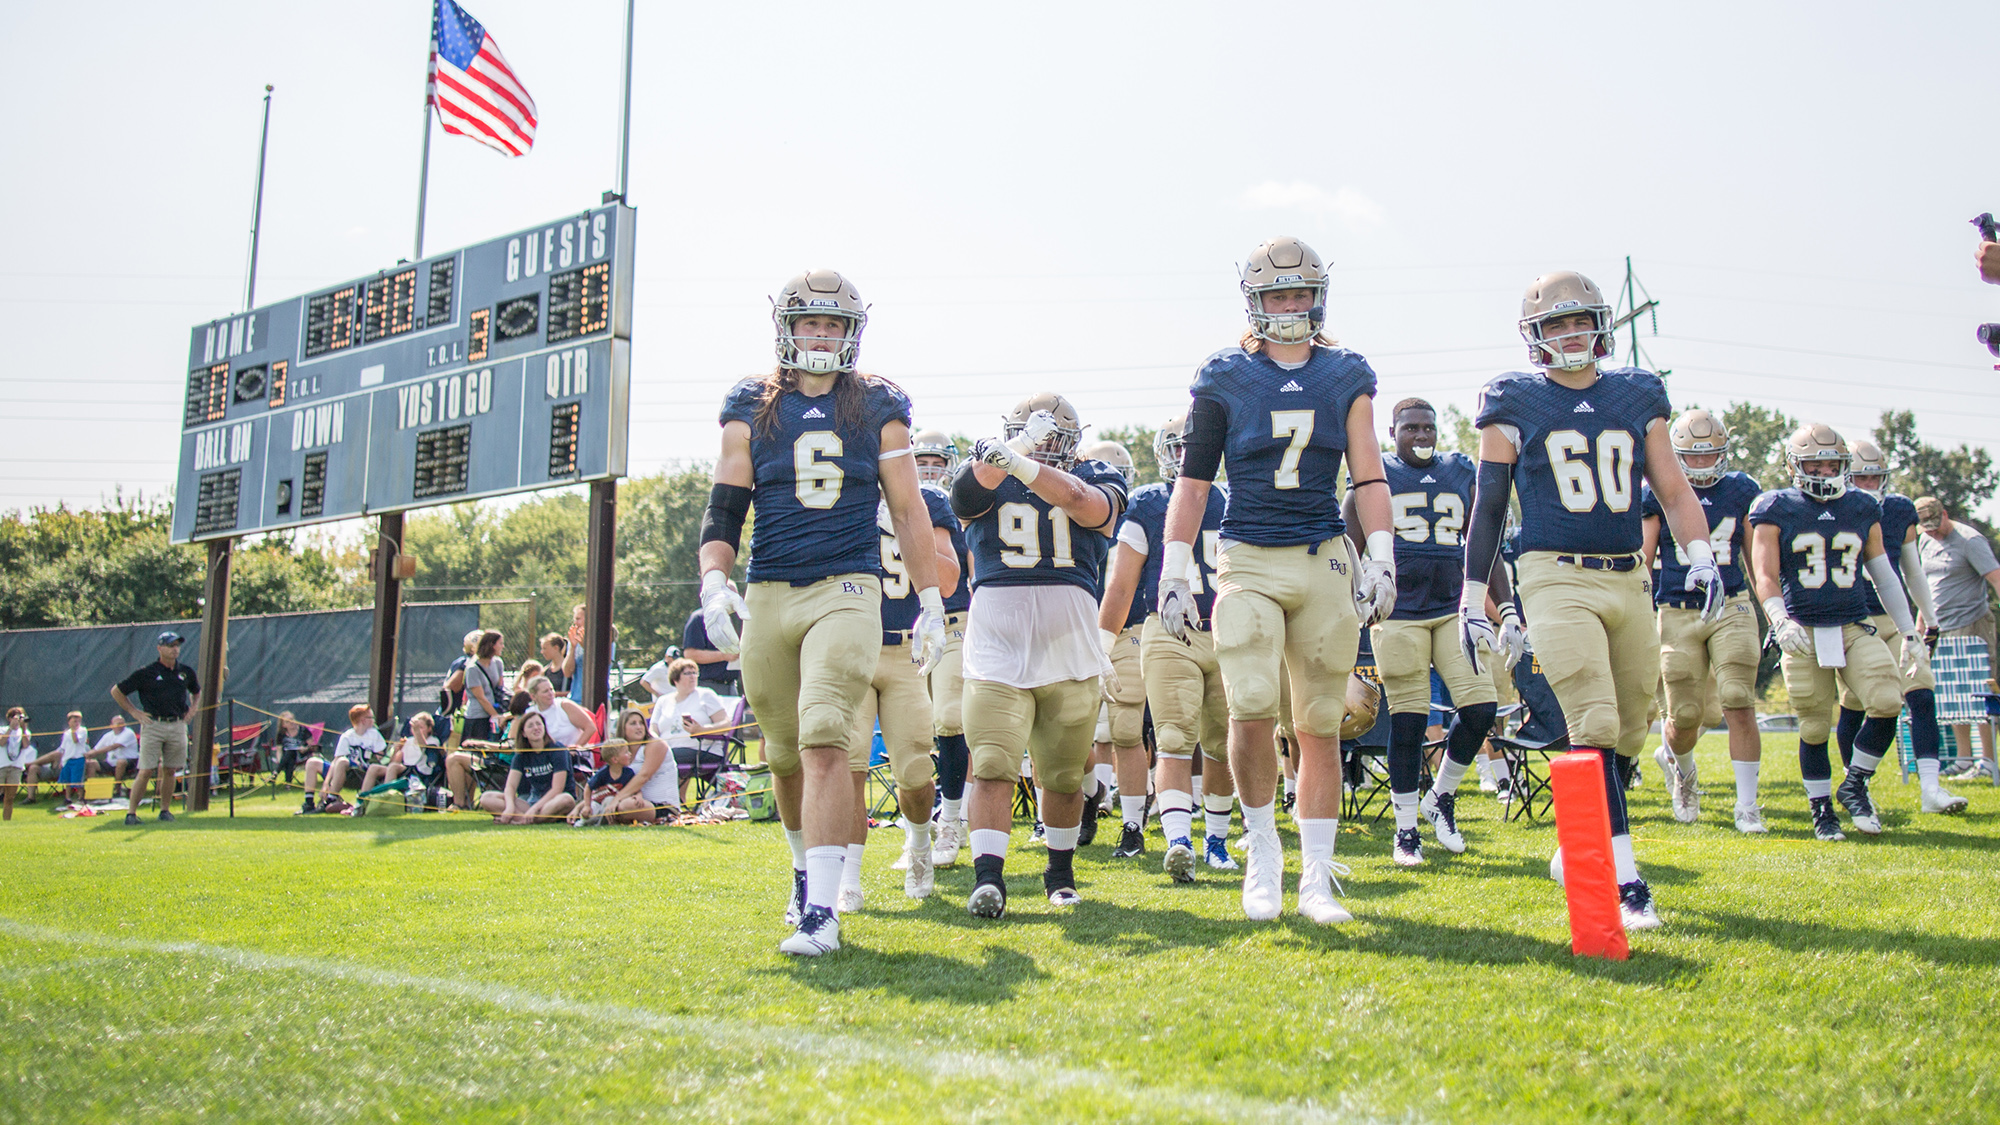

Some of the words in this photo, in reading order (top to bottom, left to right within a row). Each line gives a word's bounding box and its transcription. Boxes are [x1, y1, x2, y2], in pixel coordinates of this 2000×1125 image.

[506, 213, 607, 283] GUESTS
[203, 314, 257, 365] HOME
[398, 381, 434, 430] YDS
[438, 375, 462, 422] TO
[464, 368, 492, 417] GO
[546, 347, 589, 400] QTR
[194, 428, 227, 472] BALL
[230, 421, 252, 464] ON
[291, 401, 345, 452] DOWN
[1270, 409, 1316, 490] 7
[793, 430, 845, 510] 6
[1544, 429, 1635, 513] 60
[998, 501, 1077, 569] 91
[1391, 491, 1465, 546] 52
[841, 581, 864, 595] BU
[1328, 558, 1347, 576] BU
[1792, 531, 1863, 589] 33
